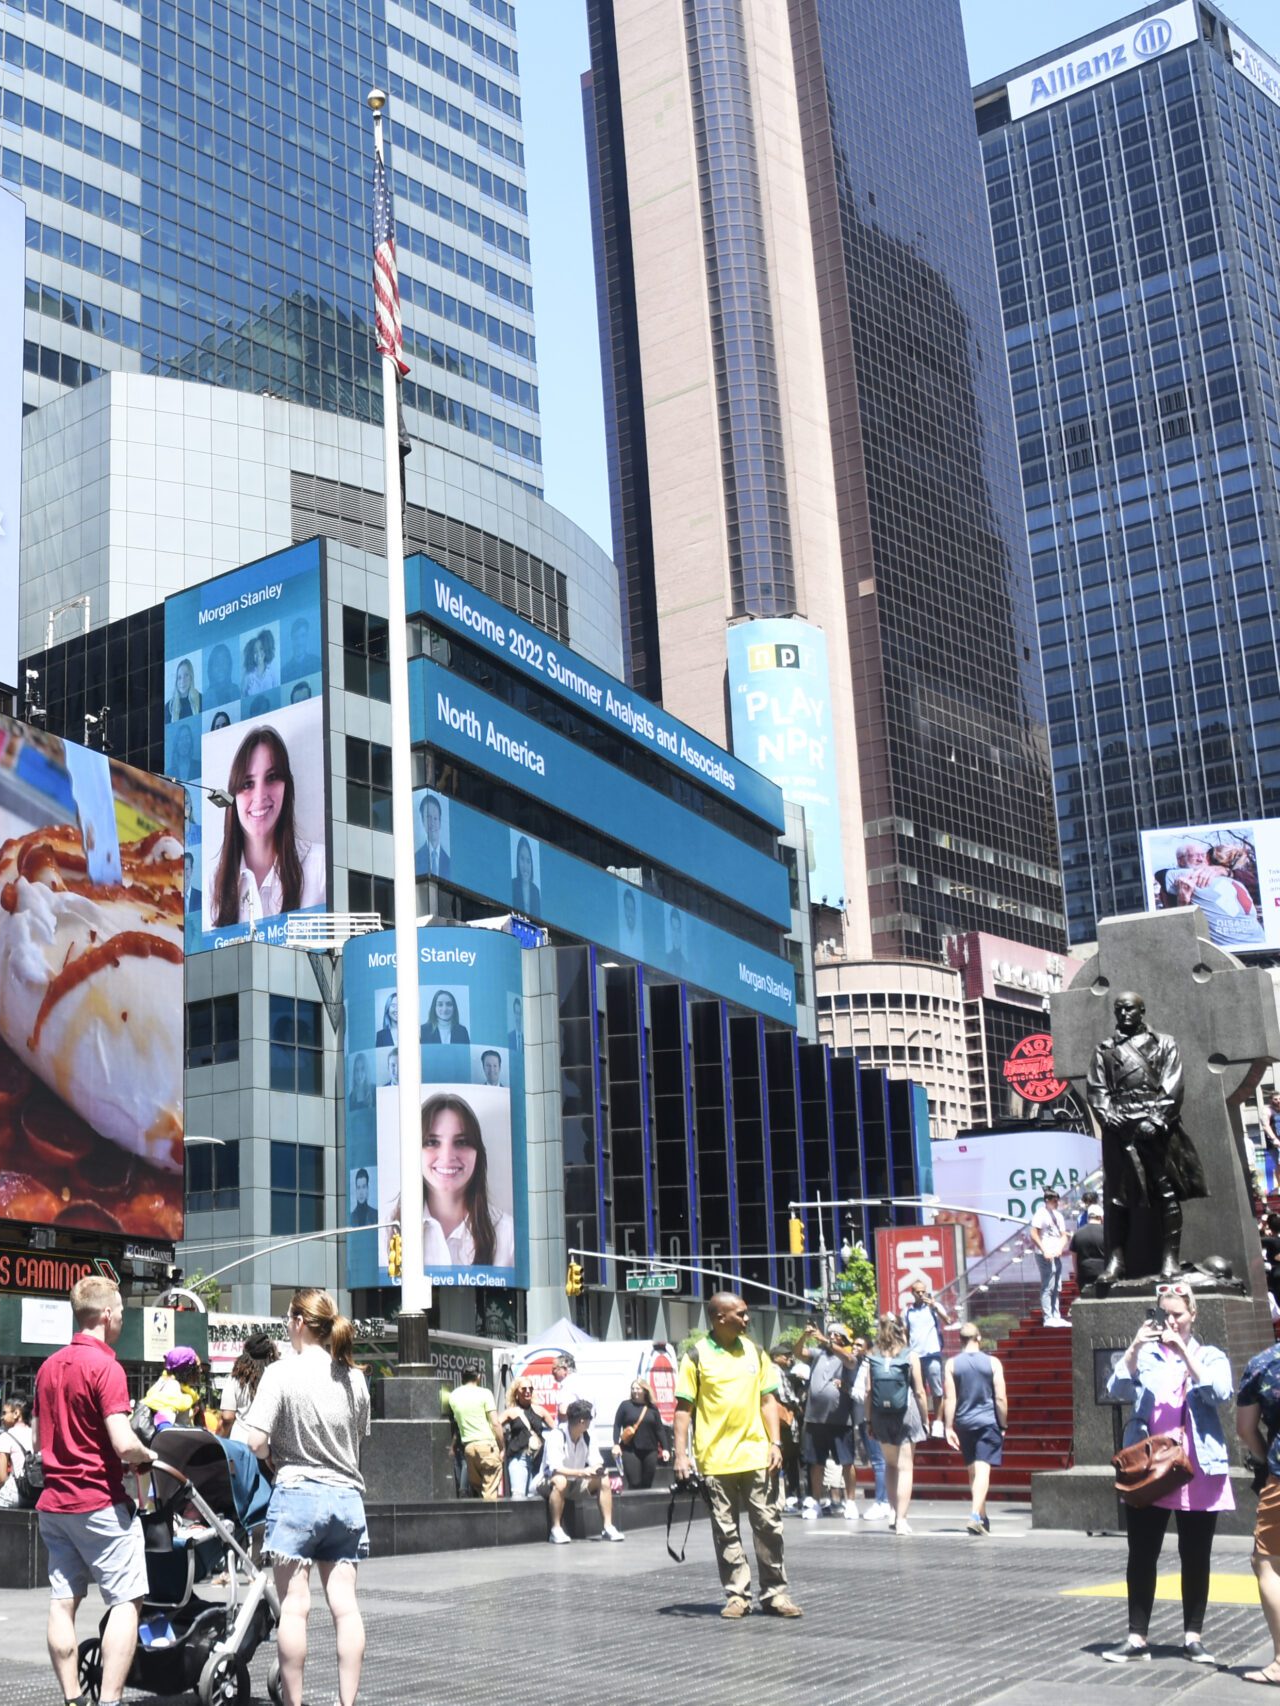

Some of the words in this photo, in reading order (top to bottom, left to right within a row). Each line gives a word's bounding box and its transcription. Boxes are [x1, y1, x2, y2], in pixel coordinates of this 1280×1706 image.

[1030, 43, 1128, 107] Allianz
[198, 599, 239, 626] Morgan
[240, 582, 284, 609] Stanley
[434, 579, 506, 646] Welcome
[508, 627, 544, 671] 2022
[546, 651, 604, 707] Summer
[605, 689, 655, 741] Analysts
[656, 727, 677, 756] and
[679, 736, 736, 792] Associates
[437, 692, 481, 743] North
[484, 720, 546, 777] America
[421, 947, 477, 966] Stanley
[739, 962, 767, 992] Morgan
[766, 974, 793, 1007] Stanley
[1023, 1078, 1060, 1097] NOW
[458, 1273, 507, 1288] McClean
[647, 1278, 656, 1287] 47
